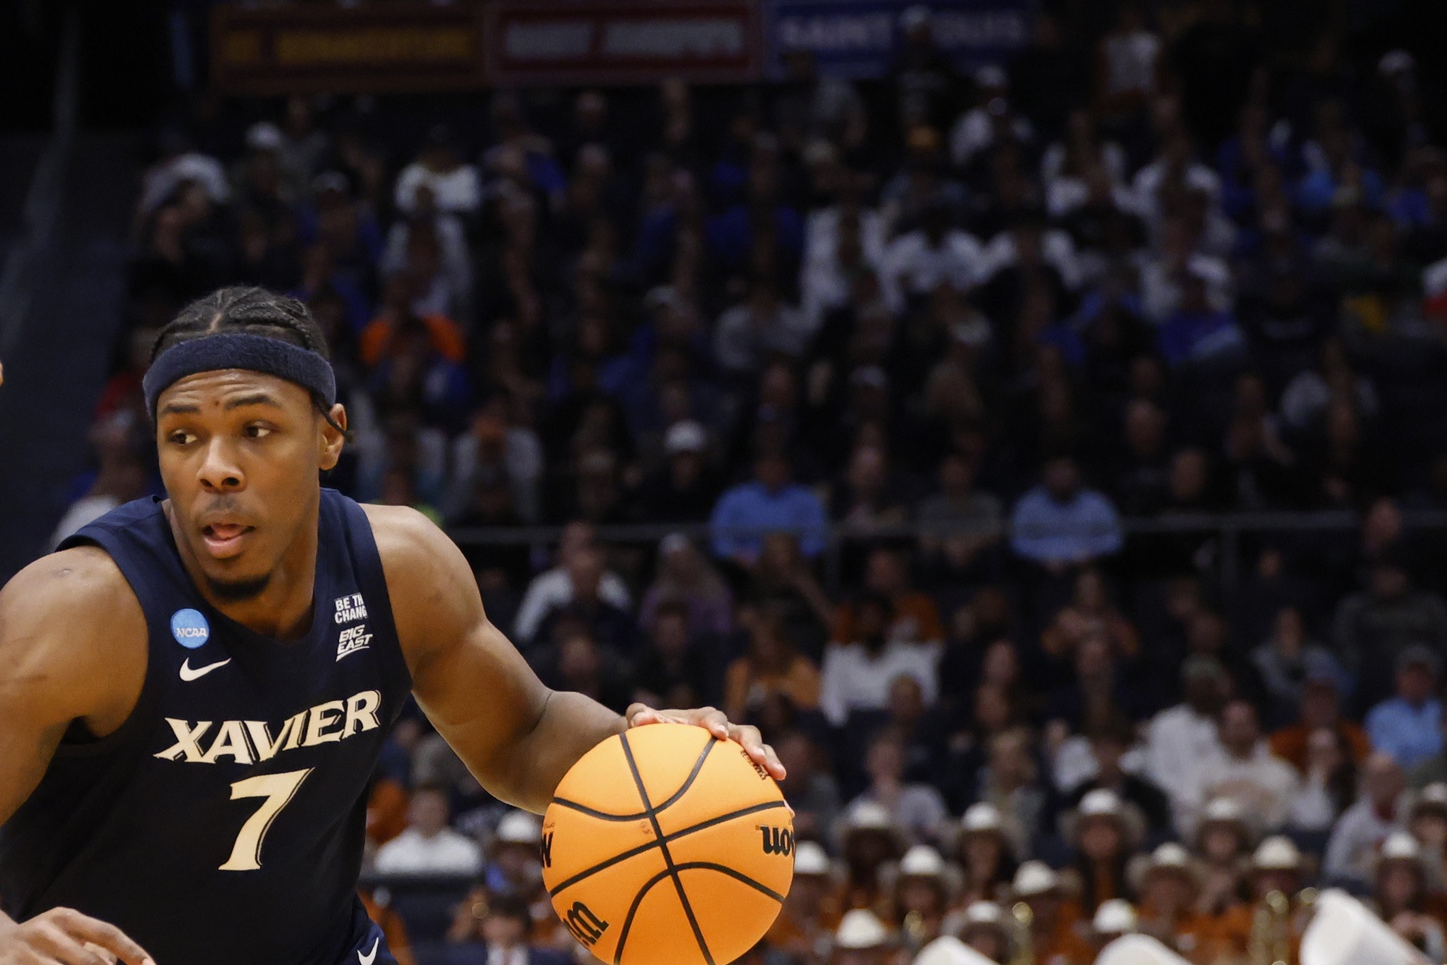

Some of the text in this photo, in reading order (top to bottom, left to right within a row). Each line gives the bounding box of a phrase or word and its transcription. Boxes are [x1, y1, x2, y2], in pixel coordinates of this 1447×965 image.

[335, 594, 365, 611] BE TH
[334, 605, 369, 624] CHANG
[176, 627, 208, 638] NCAA
[339, 624, 365, 642] BIG
[337, 634, 373, 655] EAST
[153, 689, 382, 765] XAVIER
[218, 767, 316, 871] 7
